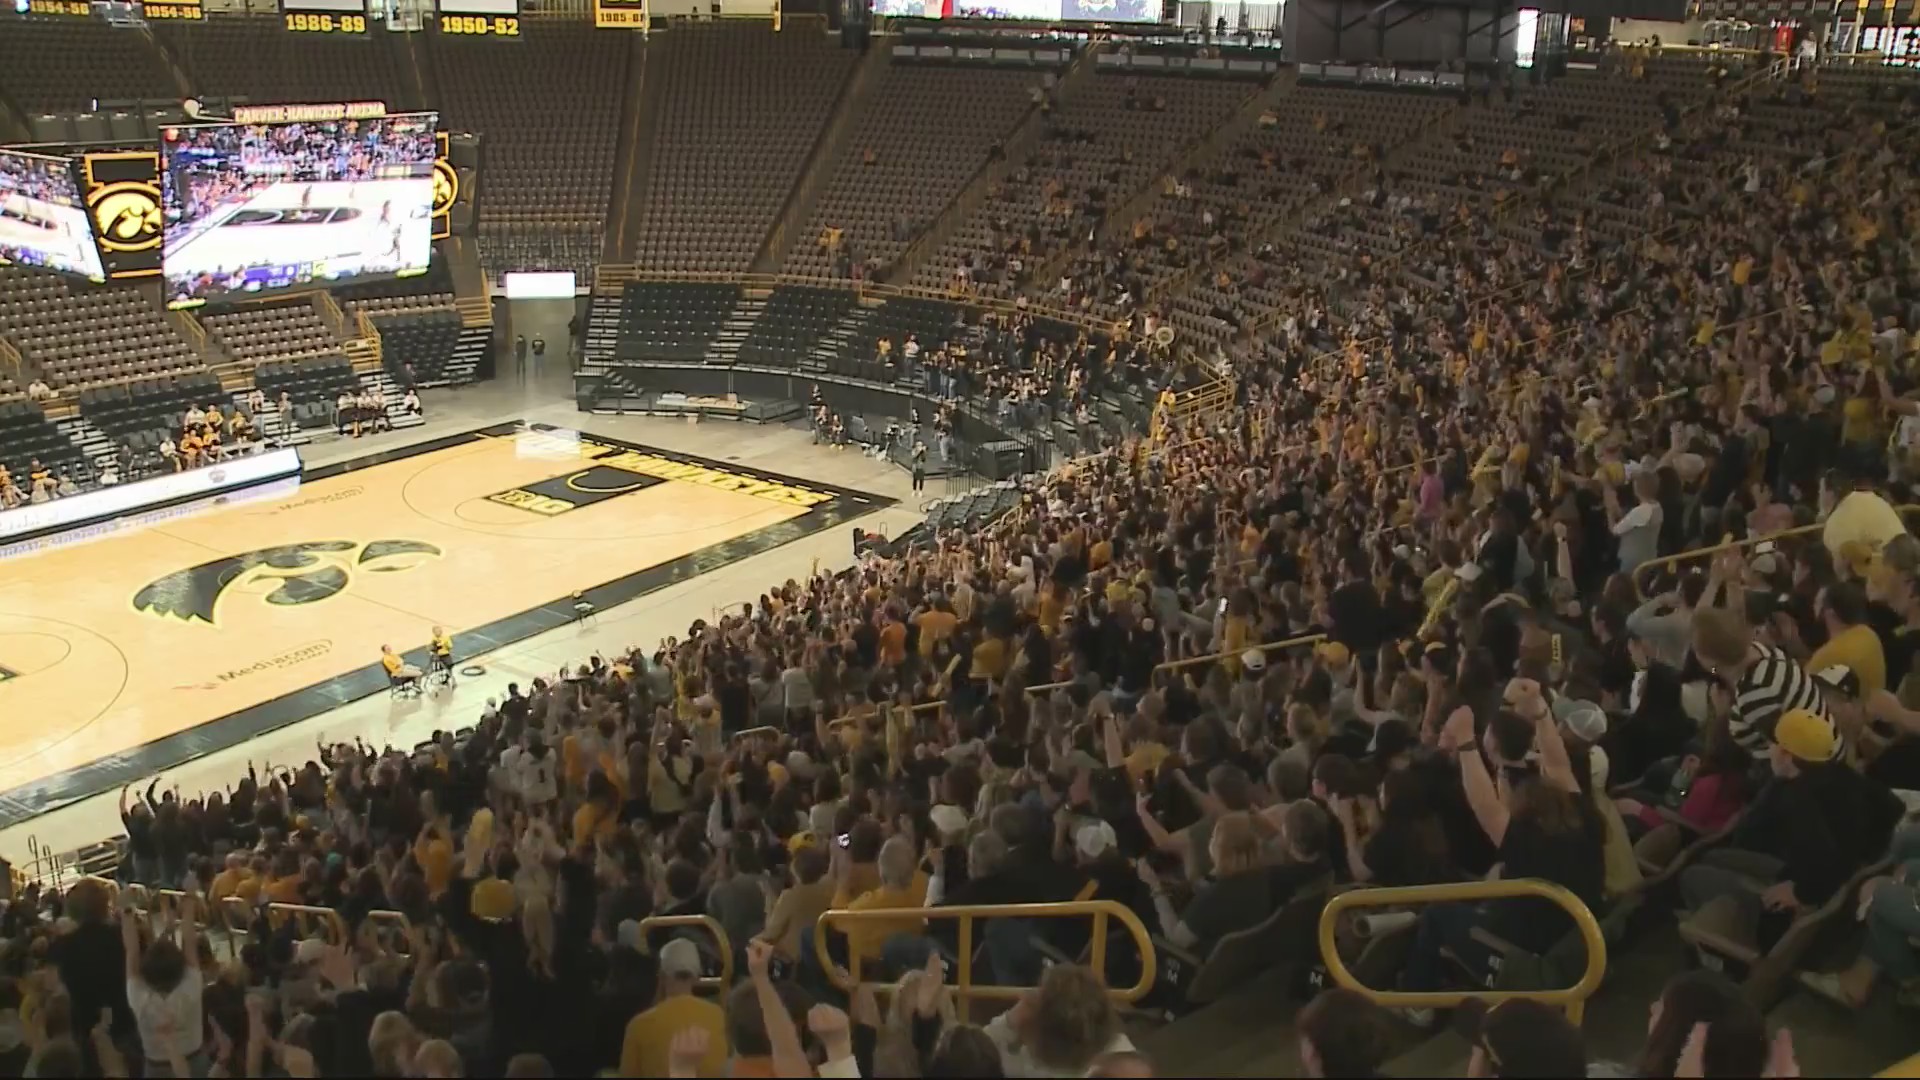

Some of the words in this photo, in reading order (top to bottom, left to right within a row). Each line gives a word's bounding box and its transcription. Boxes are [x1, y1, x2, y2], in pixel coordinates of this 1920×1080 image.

[286, 14, 366, 33] 1986-89
[441, 16, 519, 36] 1950-52
[217, 643, 327, 682] Mediacom
